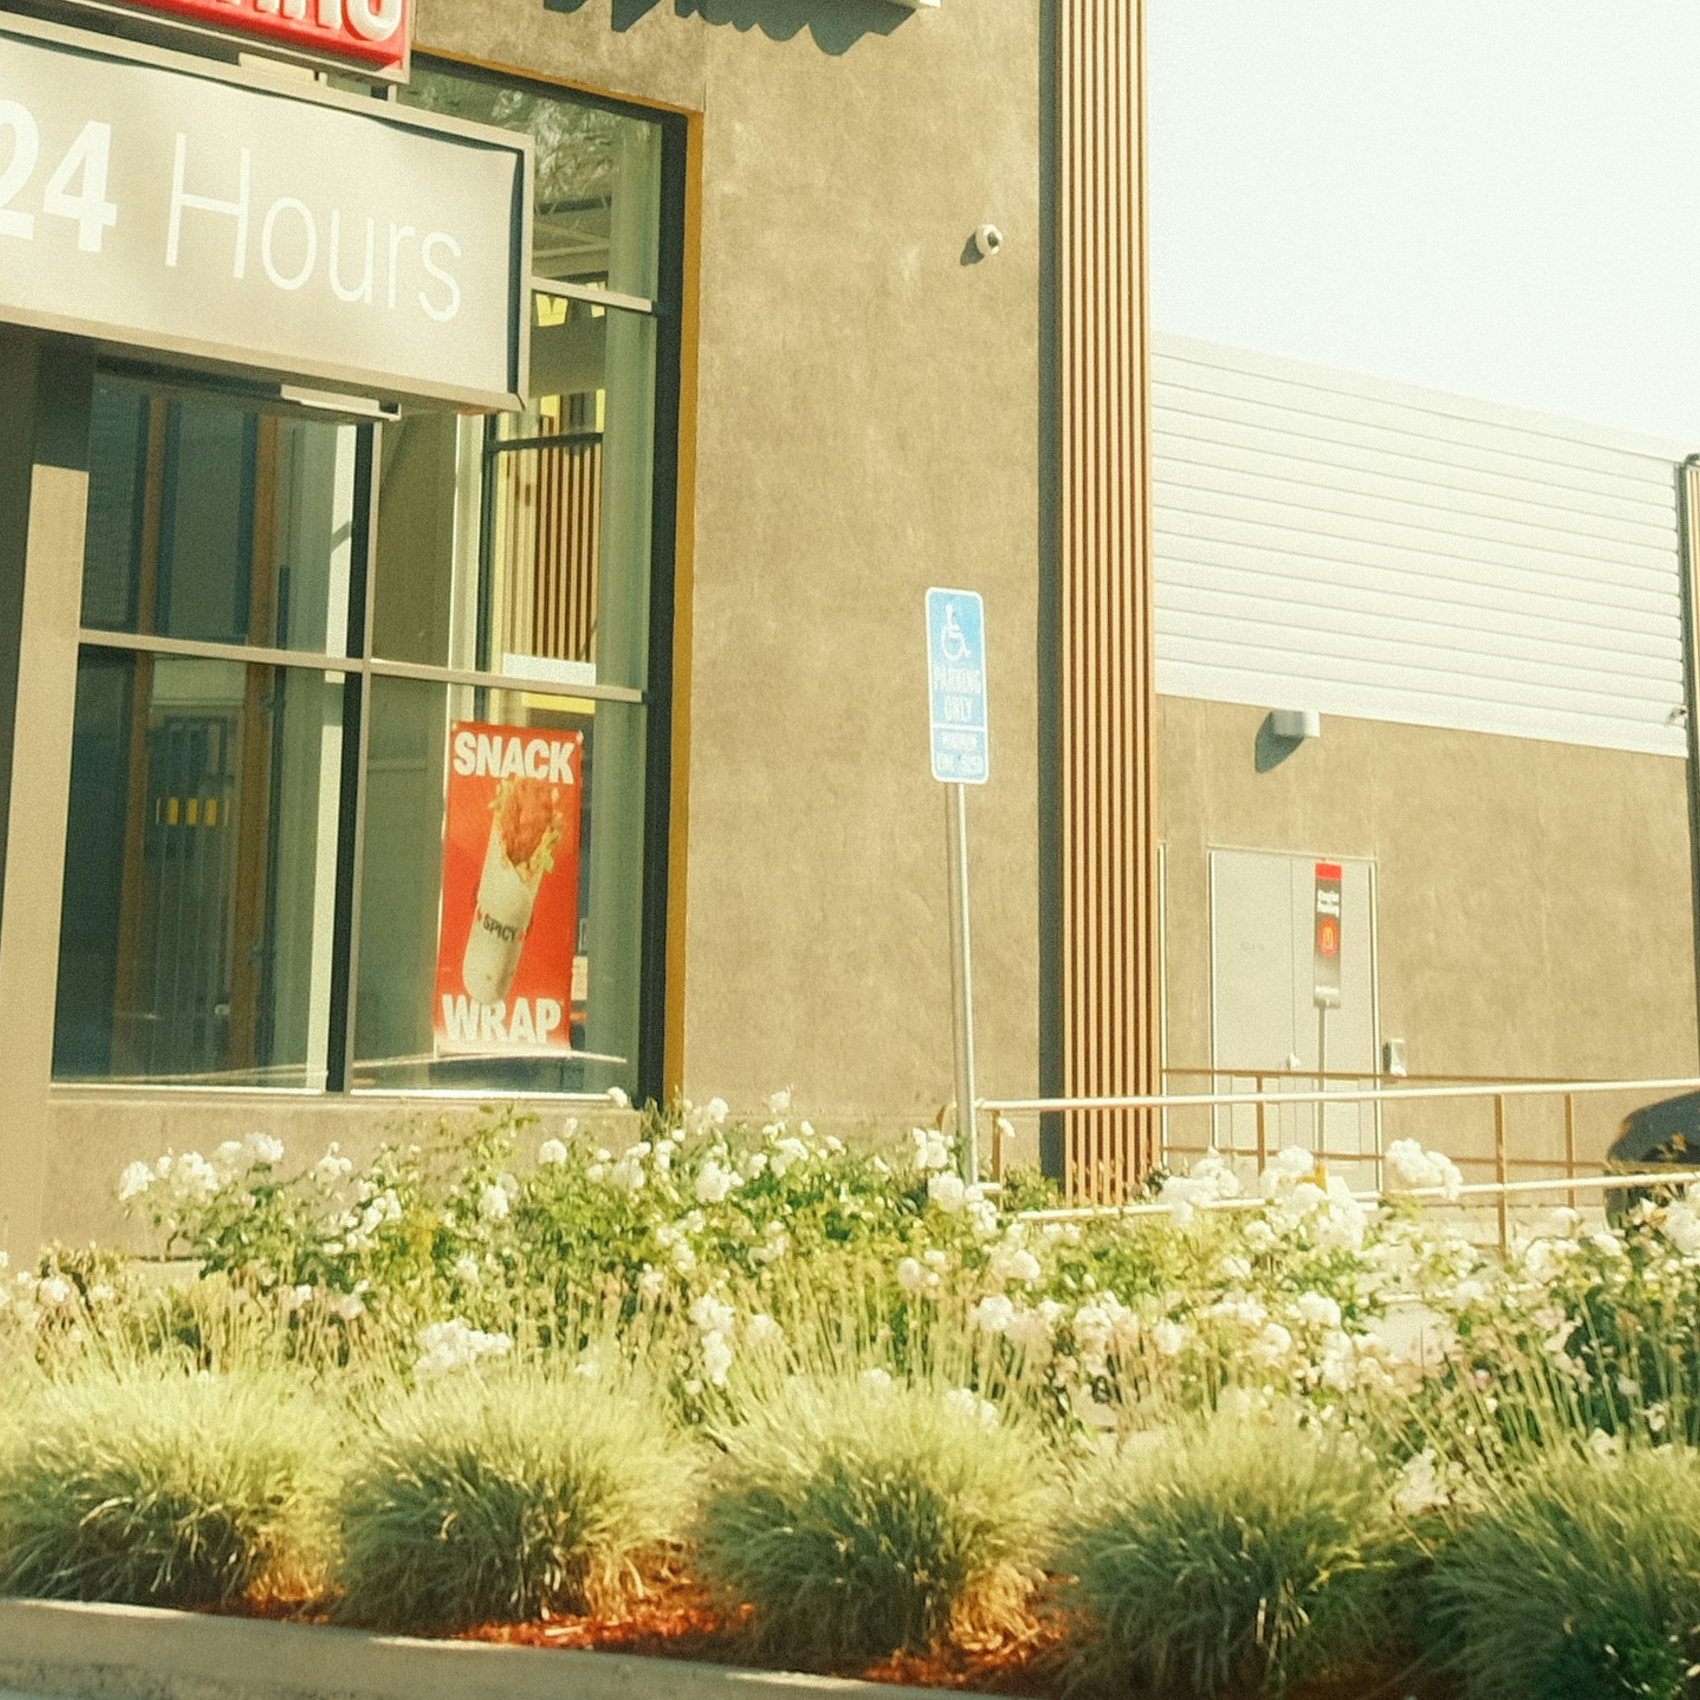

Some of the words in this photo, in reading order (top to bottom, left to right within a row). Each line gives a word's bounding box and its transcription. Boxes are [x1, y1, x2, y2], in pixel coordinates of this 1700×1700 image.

[164, 132, 464, 323] Hours
[452, 731, 575, 785] SNACK
[483, 913, 518, 943] SPICY
[441, 993, 562, 1043] WRAP
